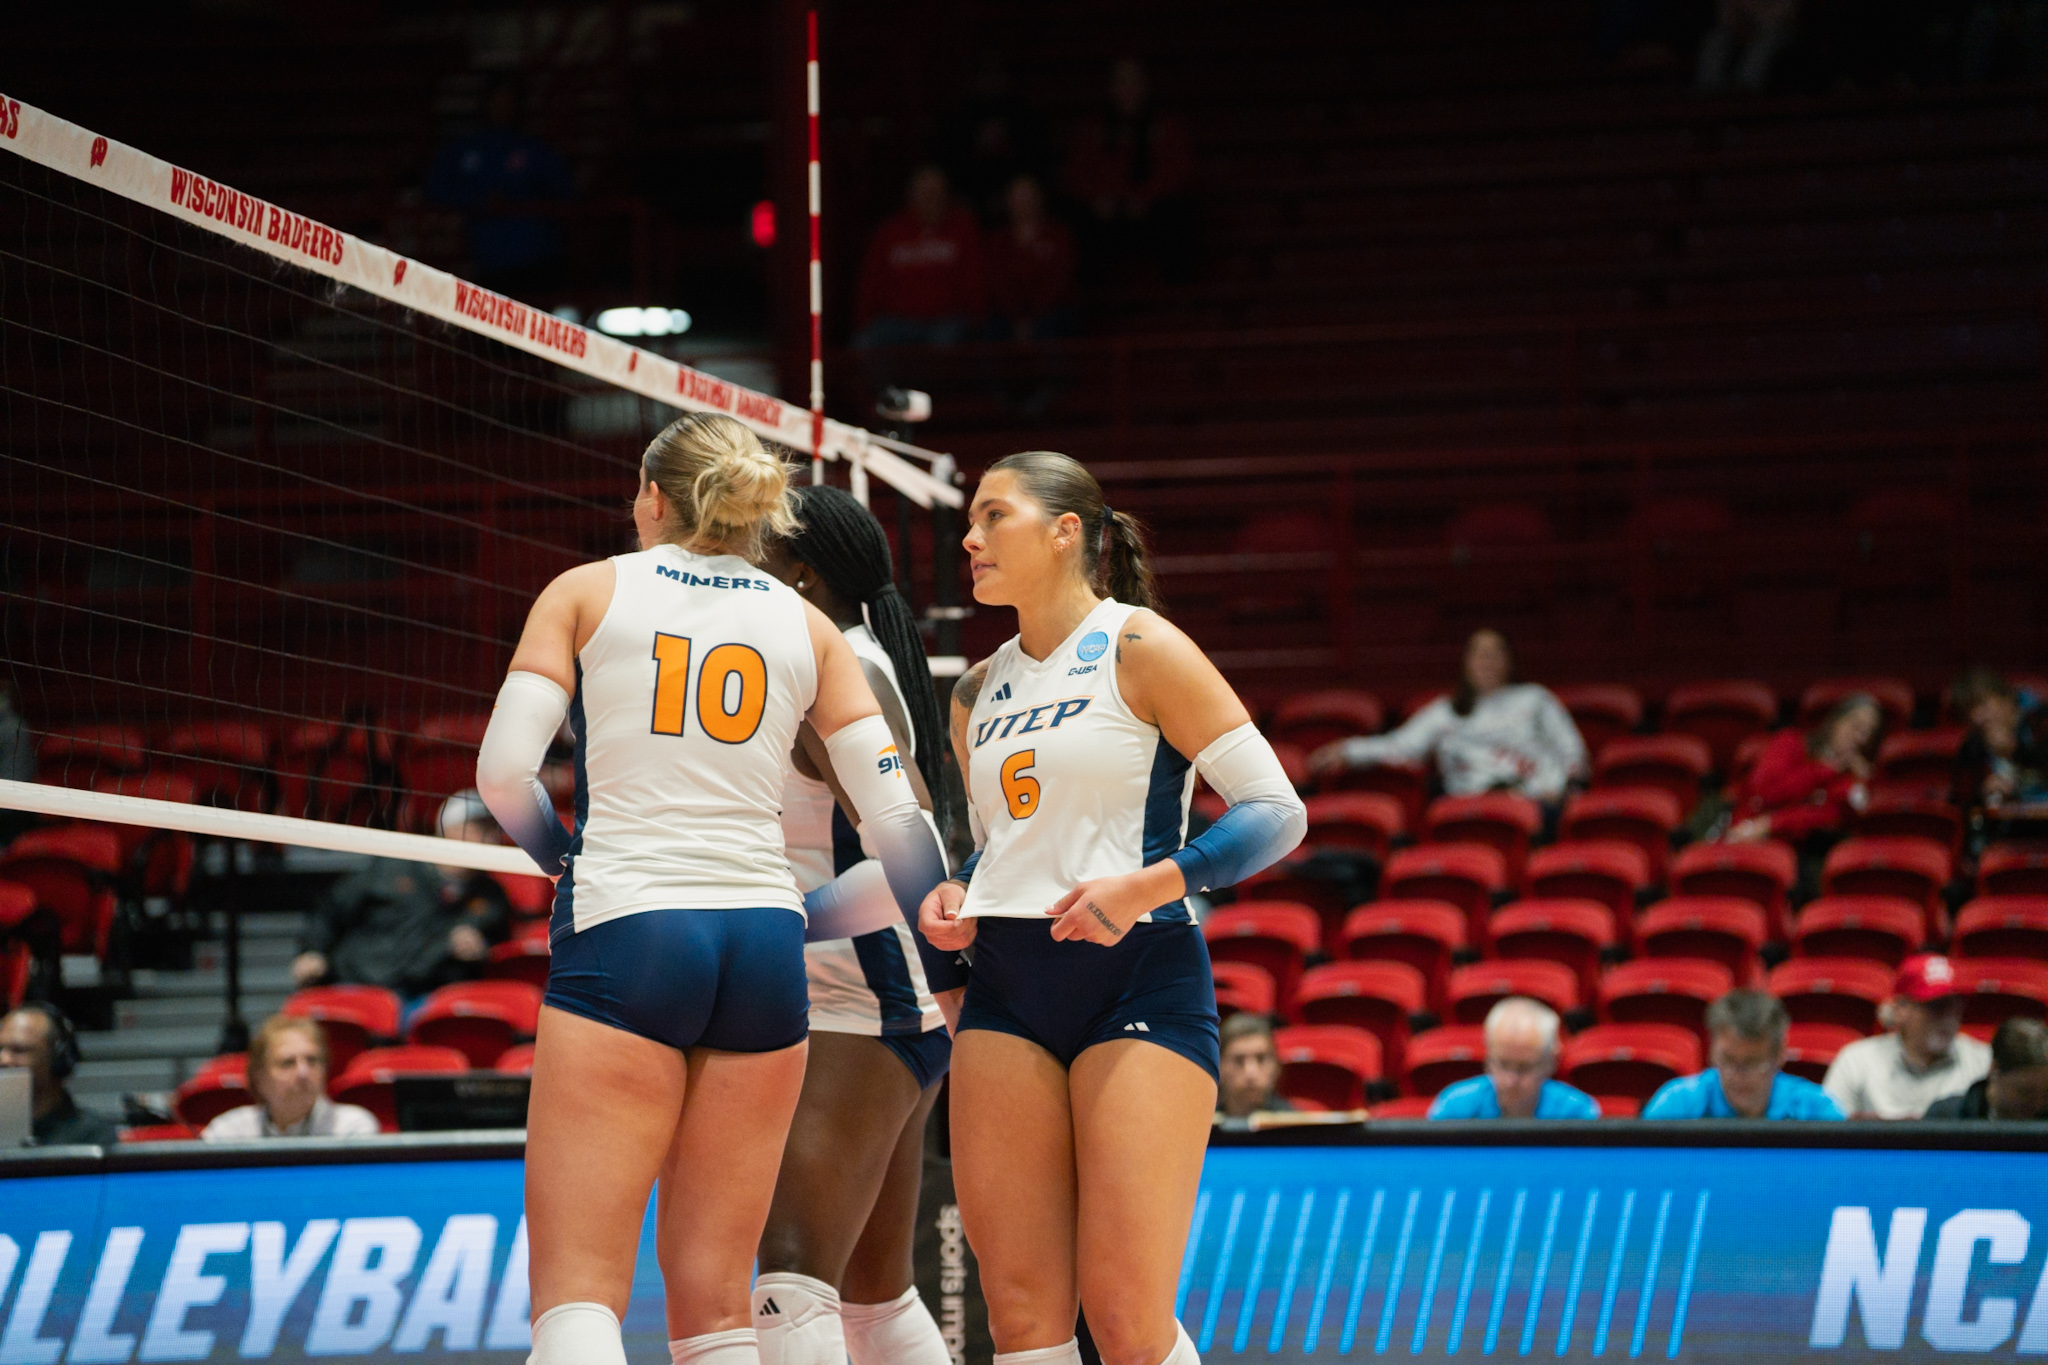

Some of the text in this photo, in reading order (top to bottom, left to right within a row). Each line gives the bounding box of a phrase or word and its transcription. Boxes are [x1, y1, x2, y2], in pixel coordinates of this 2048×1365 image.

[170, 166, 344, 265] WISCONSIN BADGERS
[455, 281, 527, 336] WISCONSIN
[656, 565, 770, 591] MINERS
[651, 631, 768, 745] 10
[974, 695, 1096, 750] UTEP
[1000, 748, 1041, 821] 6
